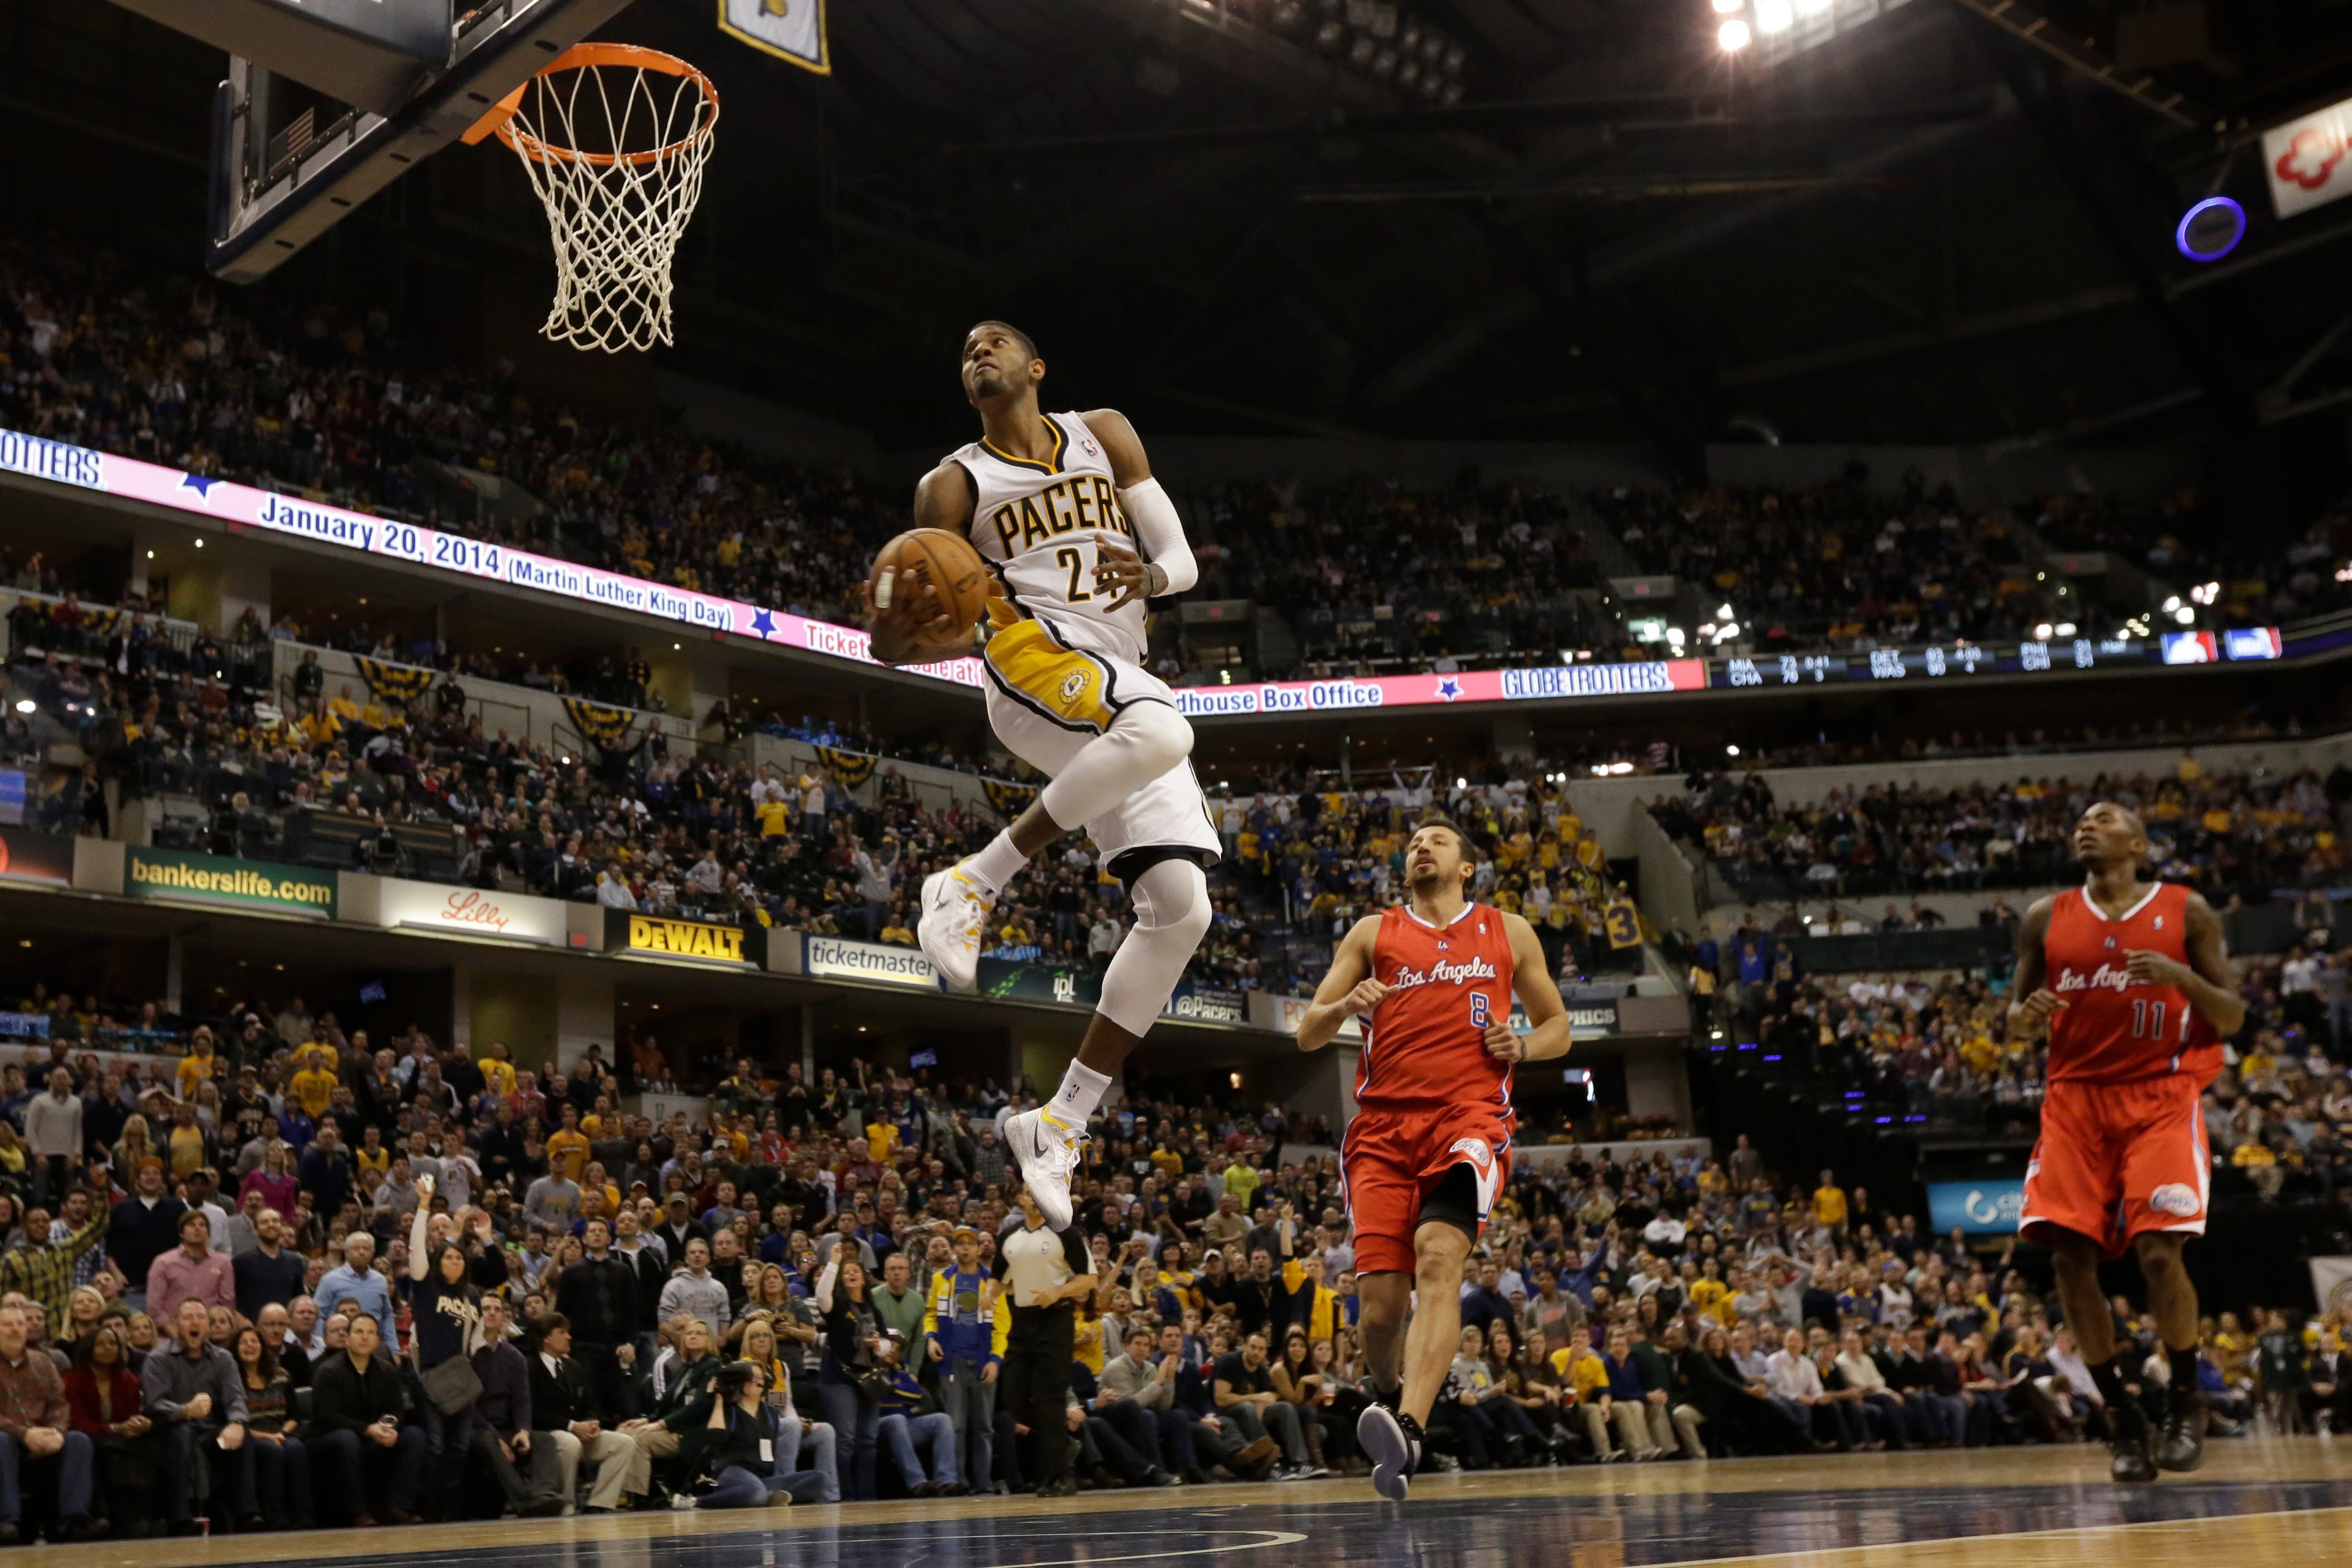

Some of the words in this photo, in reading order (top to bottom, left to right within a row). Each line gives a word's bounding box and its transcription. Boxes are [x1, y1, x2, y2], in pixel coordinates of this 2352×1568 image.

[262, 497, 373, 551] January
[385, 525, 424, 564] 20,
[436, 536, 499, 573] 2014
[509, 558, 577, 591] (Martin
[586, 576, 643, 606] Luther
[650, 590, 687, 622] King
[694, 601, 731, 631] Day)
[808, 625, 875, 661] Ticket
[956, 663, 973, 683] at
[1264, 689, 1305, 708] Box
[1313, 684, 1380, 705] Office
[1505, 662, 1666, 695] GLOBETROTTERS
[132, 856, 332, 904] bankerslife.com
[441, 891, 510, 933] Lilly
[1608, 905, 1637, 943] 3
[812, 942, 933, 977] ticketmaster
[1397, 965, 1426, 990] Los
[1426, 956, 1497, 985] Angeles
[1469, 991, 1489, 1030] 8
[2131, 998, 2166, 1042] 11
